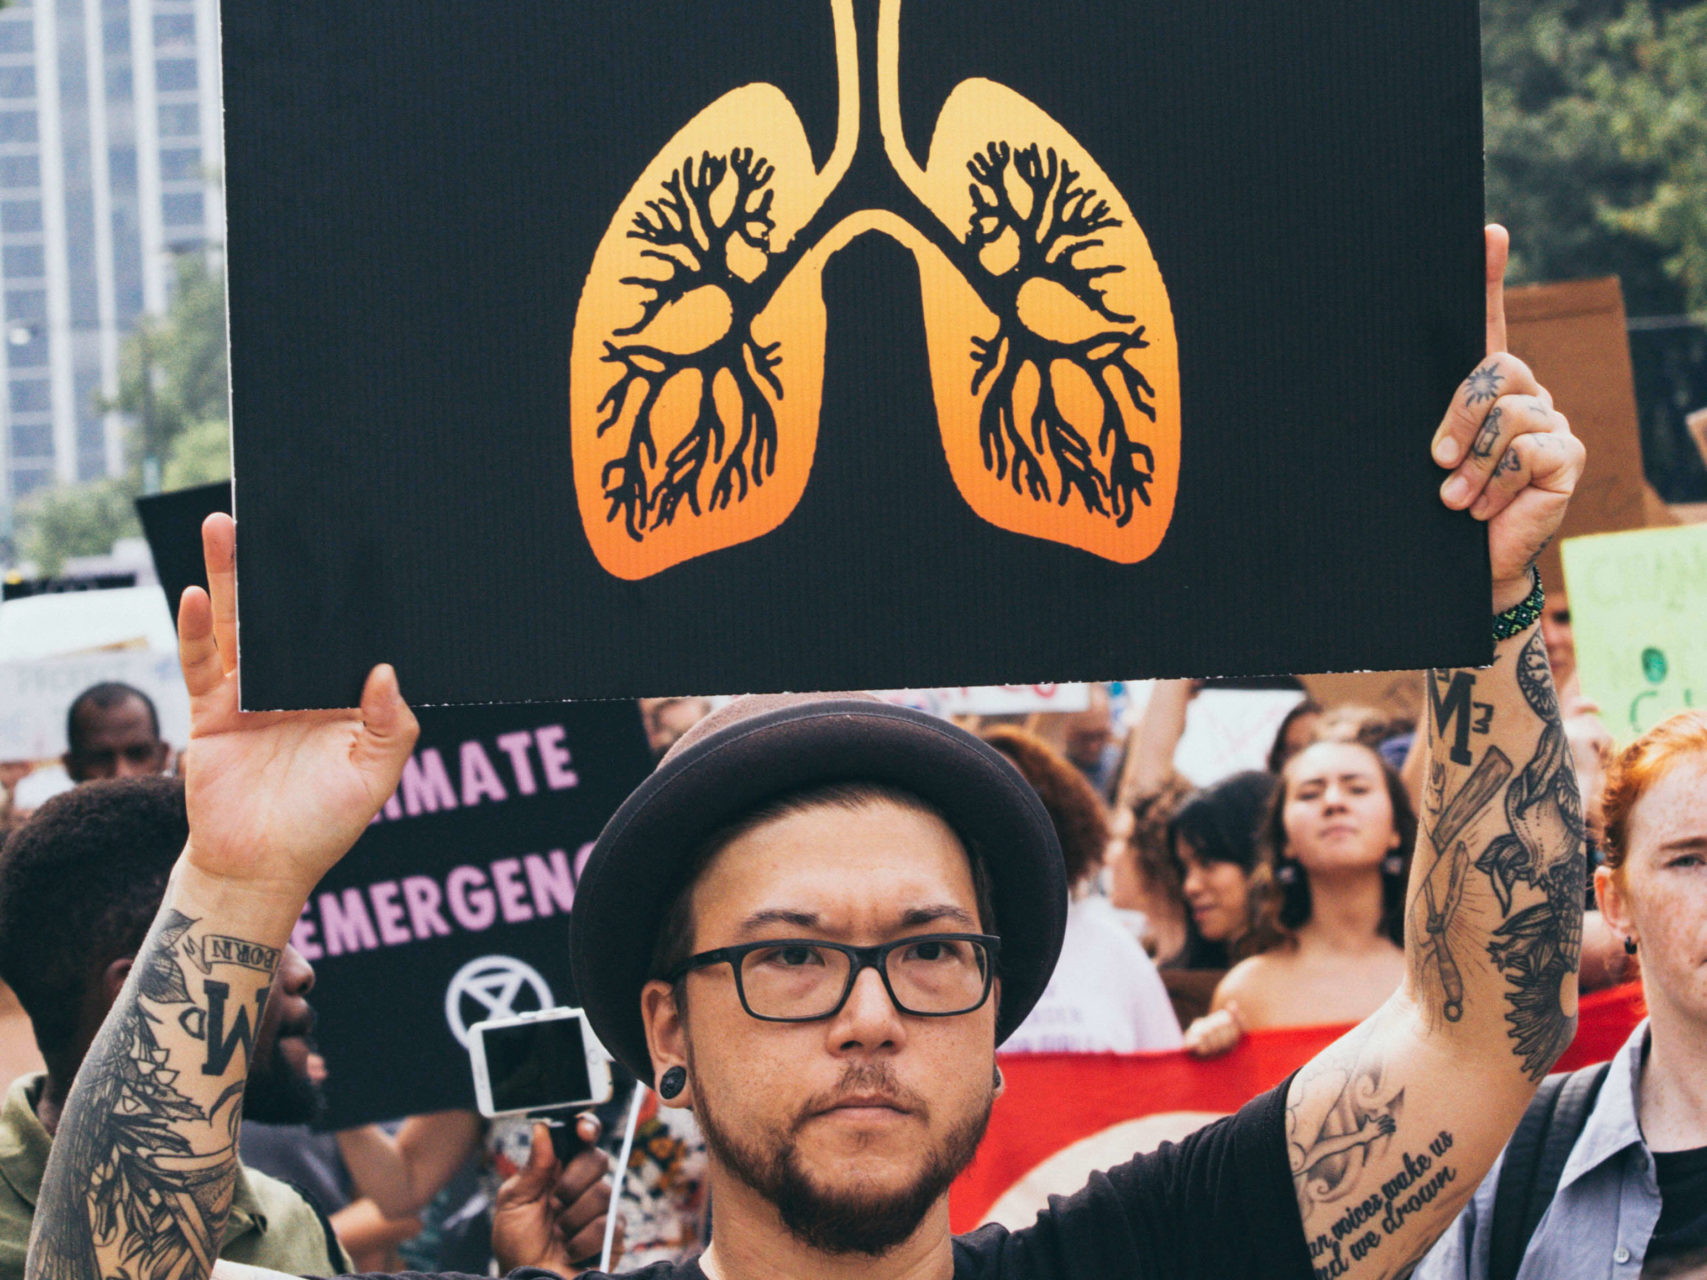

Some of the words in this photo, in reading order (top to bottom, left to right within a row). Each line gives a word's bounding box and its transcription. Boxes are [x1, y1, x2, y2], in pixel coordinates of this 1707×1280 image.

[1331, 1193, 1383, 1241] voices
[1381, 1152, 1432, 1201] wake
[1429, 1131, 1453, 1157] us
[1350, 1230, 1381, 1261] we
[1381, 1166, 1456, 1235] drown
